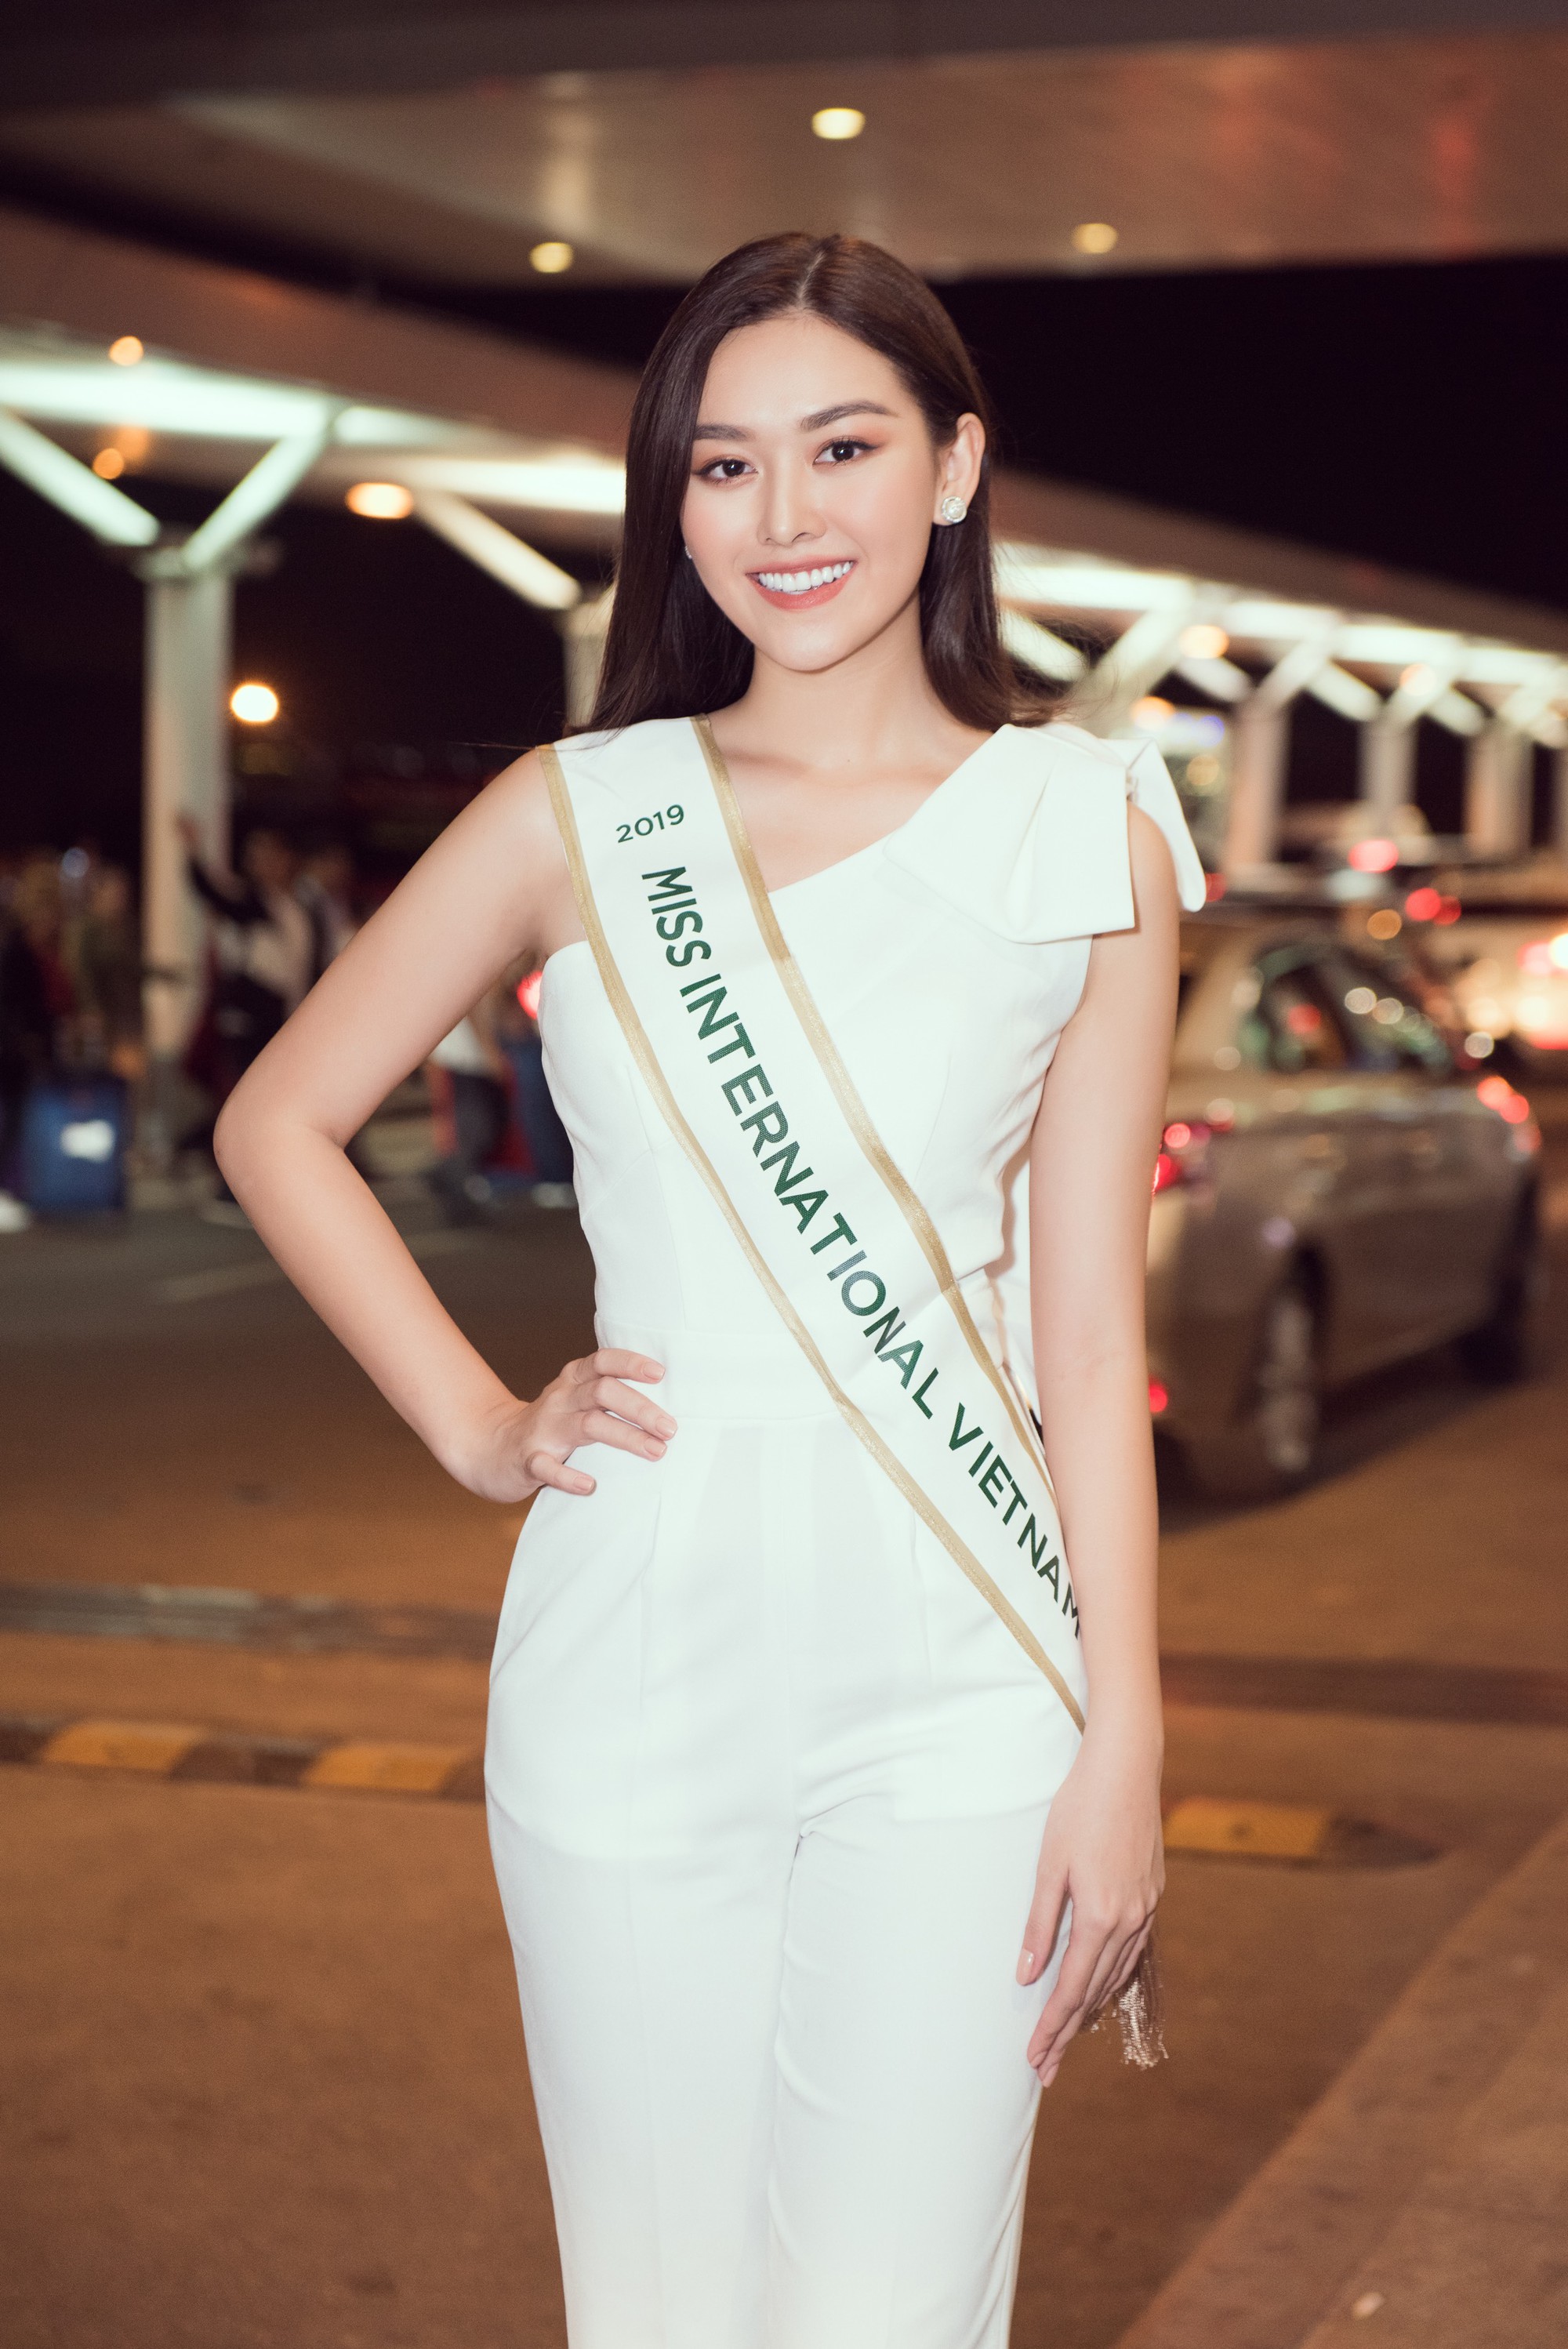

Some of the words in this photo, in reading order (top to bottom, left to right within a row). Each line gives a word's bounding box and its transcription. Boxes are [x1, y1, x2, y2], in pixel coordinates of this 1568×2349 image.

[615, 804, 684, 844] 2019
[641, 866, 712, 968] MISS
[679, 973, 939, 1420] INTERNATIONAL
[948, 1401, 1080, 1641] VIETNAM
